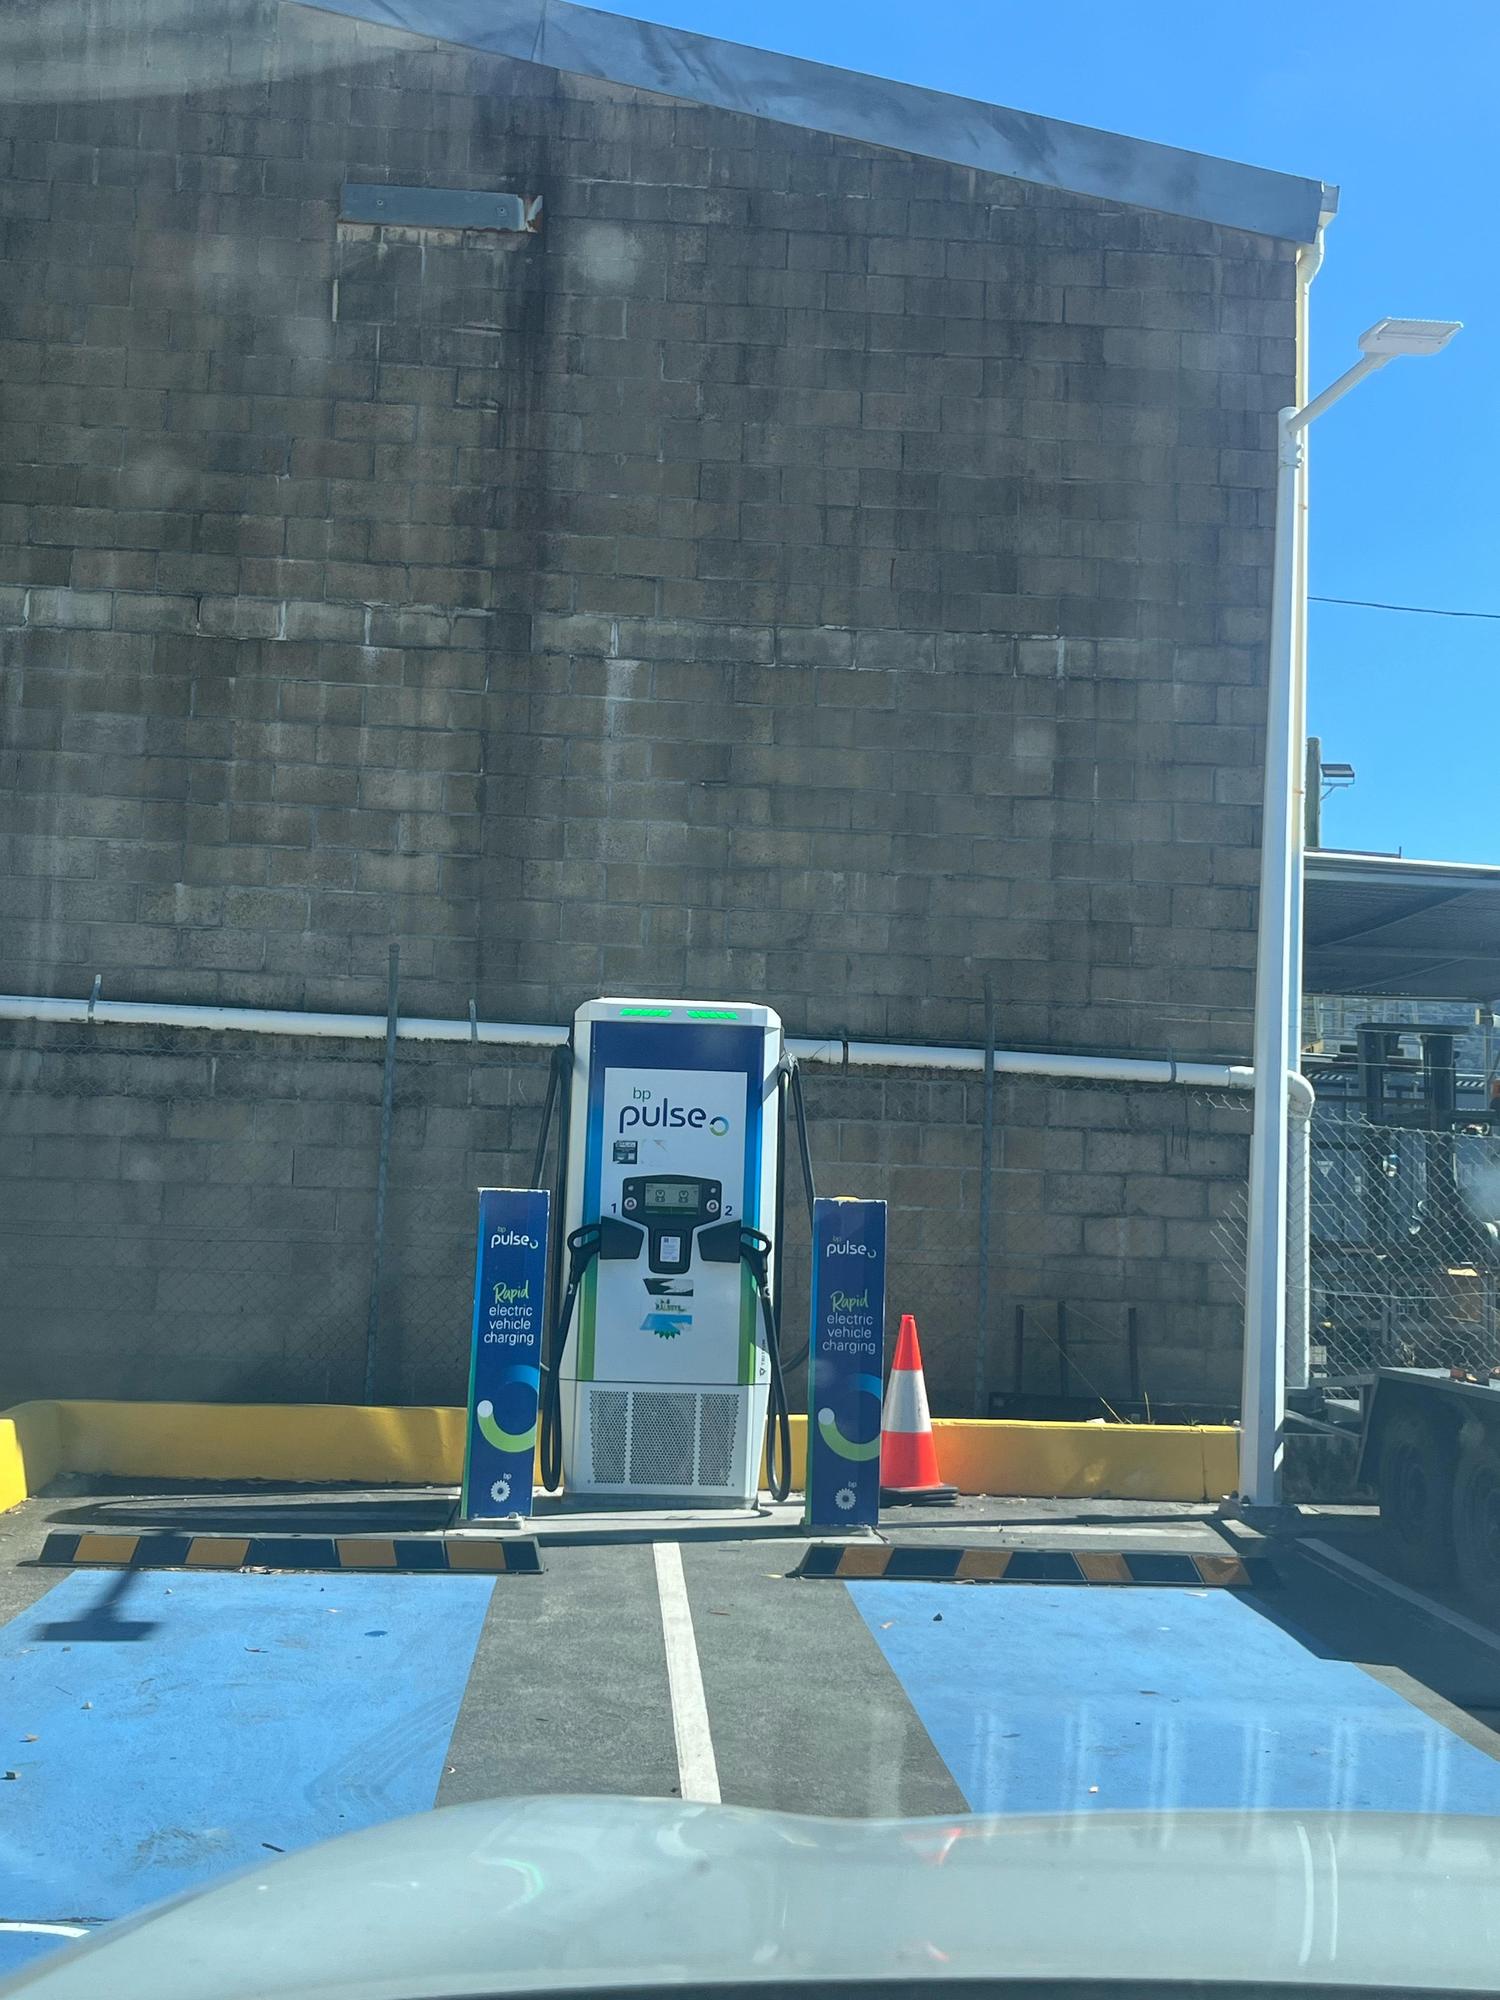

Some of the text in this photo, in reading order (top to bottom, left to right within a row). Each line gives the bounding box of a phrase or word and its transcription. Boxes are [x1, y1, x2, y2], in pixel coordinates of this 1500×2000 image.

[633, 1087, 651, 1102] bp
[619, 1097, 707, 1134] pulse
[611, 1203, 617, 1214] 1
[724, 1205, 733, 1216] 2
[497, 1226, 506, 1234] bp
[491, 1231, 530, 1249] pulse
[826, 1240, 867, 1257] pulse
[493, 1280, 529, 1304] Rapid
[830, 1288, 869, 1312] Rapid
[489, 1304, 533, 1317] electric
[489, 1317, 531, 1330] vehicle
[826, 1312, 873, 1325] electric
[483, 1331, 534, 1346] charging
[827, 1326, 872, 1339] vehicle
[822, 1340, 876, 1355] charging
[503, 1472, 512, 1480] bp
